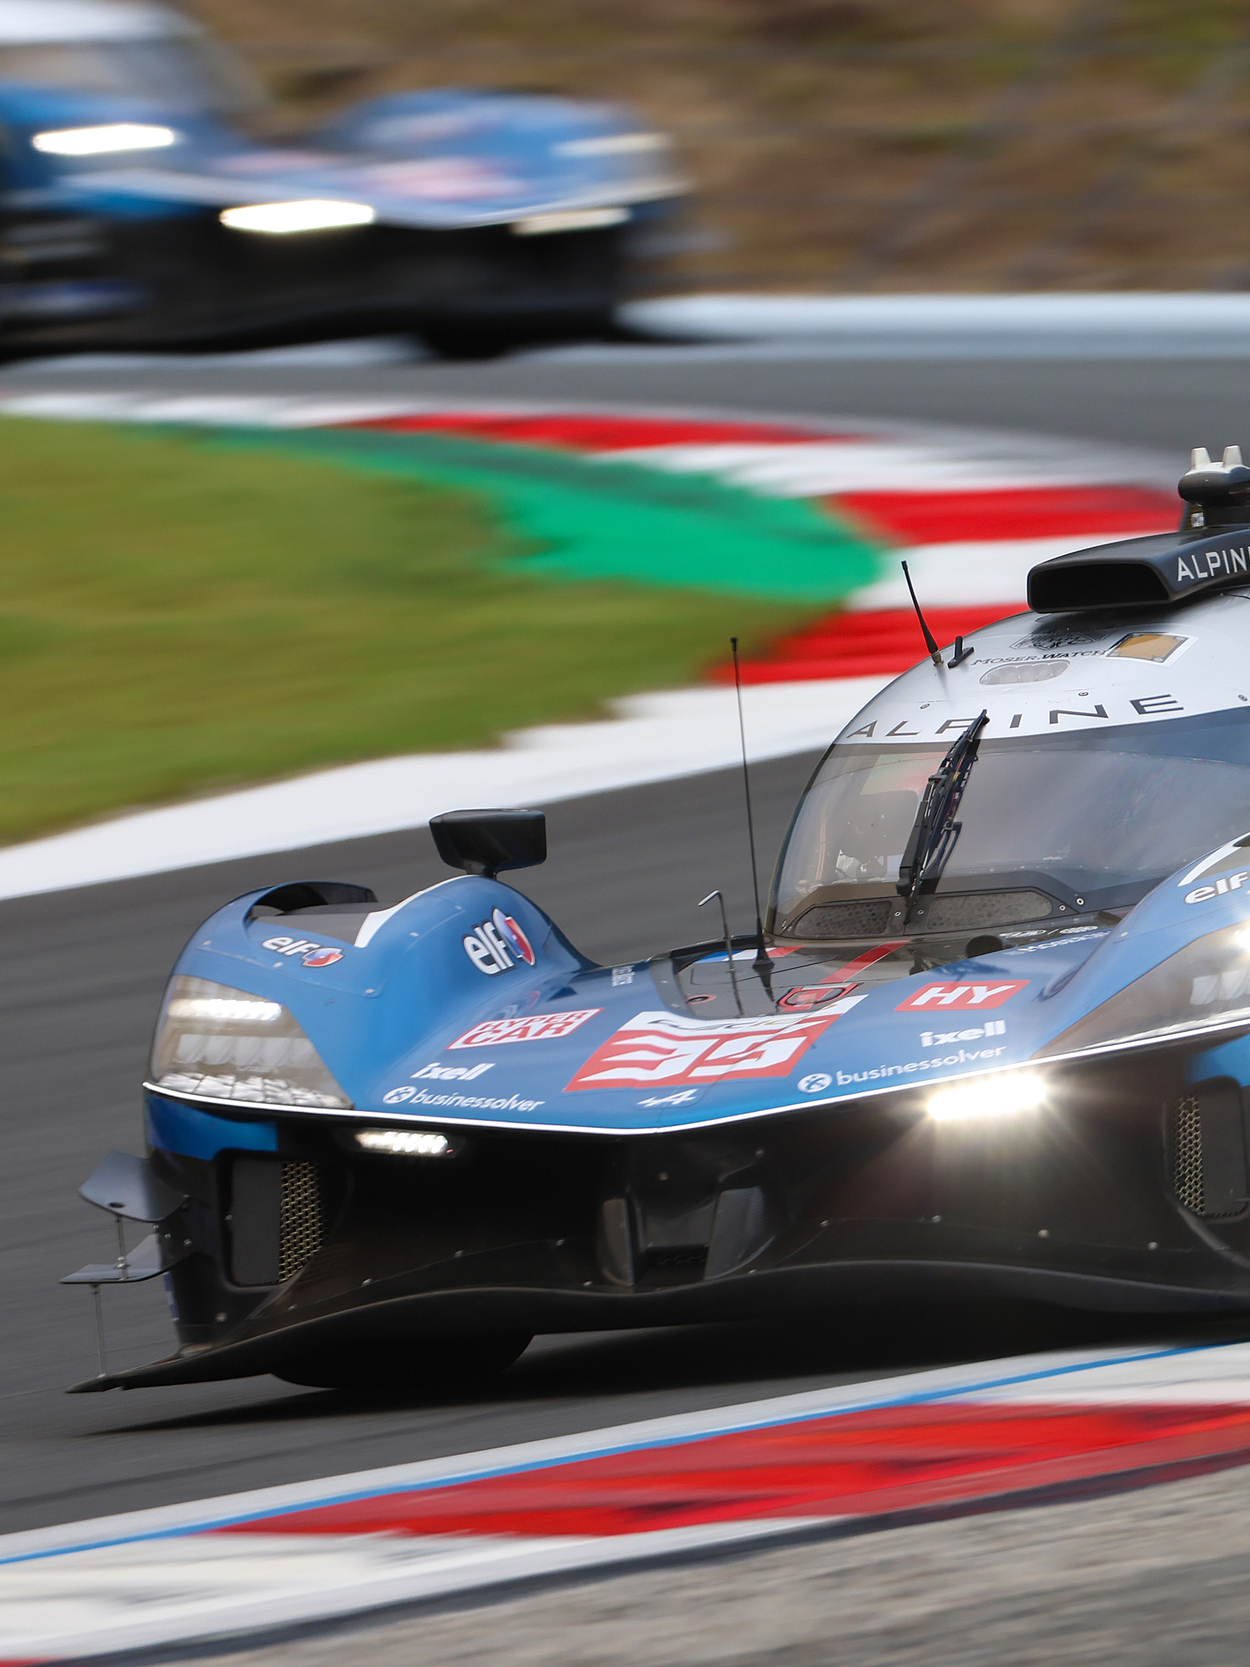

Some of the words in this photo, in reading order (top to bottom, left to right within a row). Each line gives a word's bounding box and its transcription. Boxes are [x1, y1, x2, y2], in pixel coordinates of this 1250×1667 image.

[847, 694, 1184, 739] ALPINE
[1184, 870, 1250, 903] elf
[262, 936, 322, 956] elf
[463, 921, 515, 975] elf
[910, 984, 1016, 1006] HY
[462, 1021, 574, 1045] CAR
[478, 1011, 590, 1032] HYPER
[920, 1019, 1007, 1048] ixell
[577, 1019, 829, 1082] 35
[410, 1062, 496, 1081] ixell
[836, 1045, 1008, 1087] businessolver
[409, 1088, 546, 1112] businessolver
